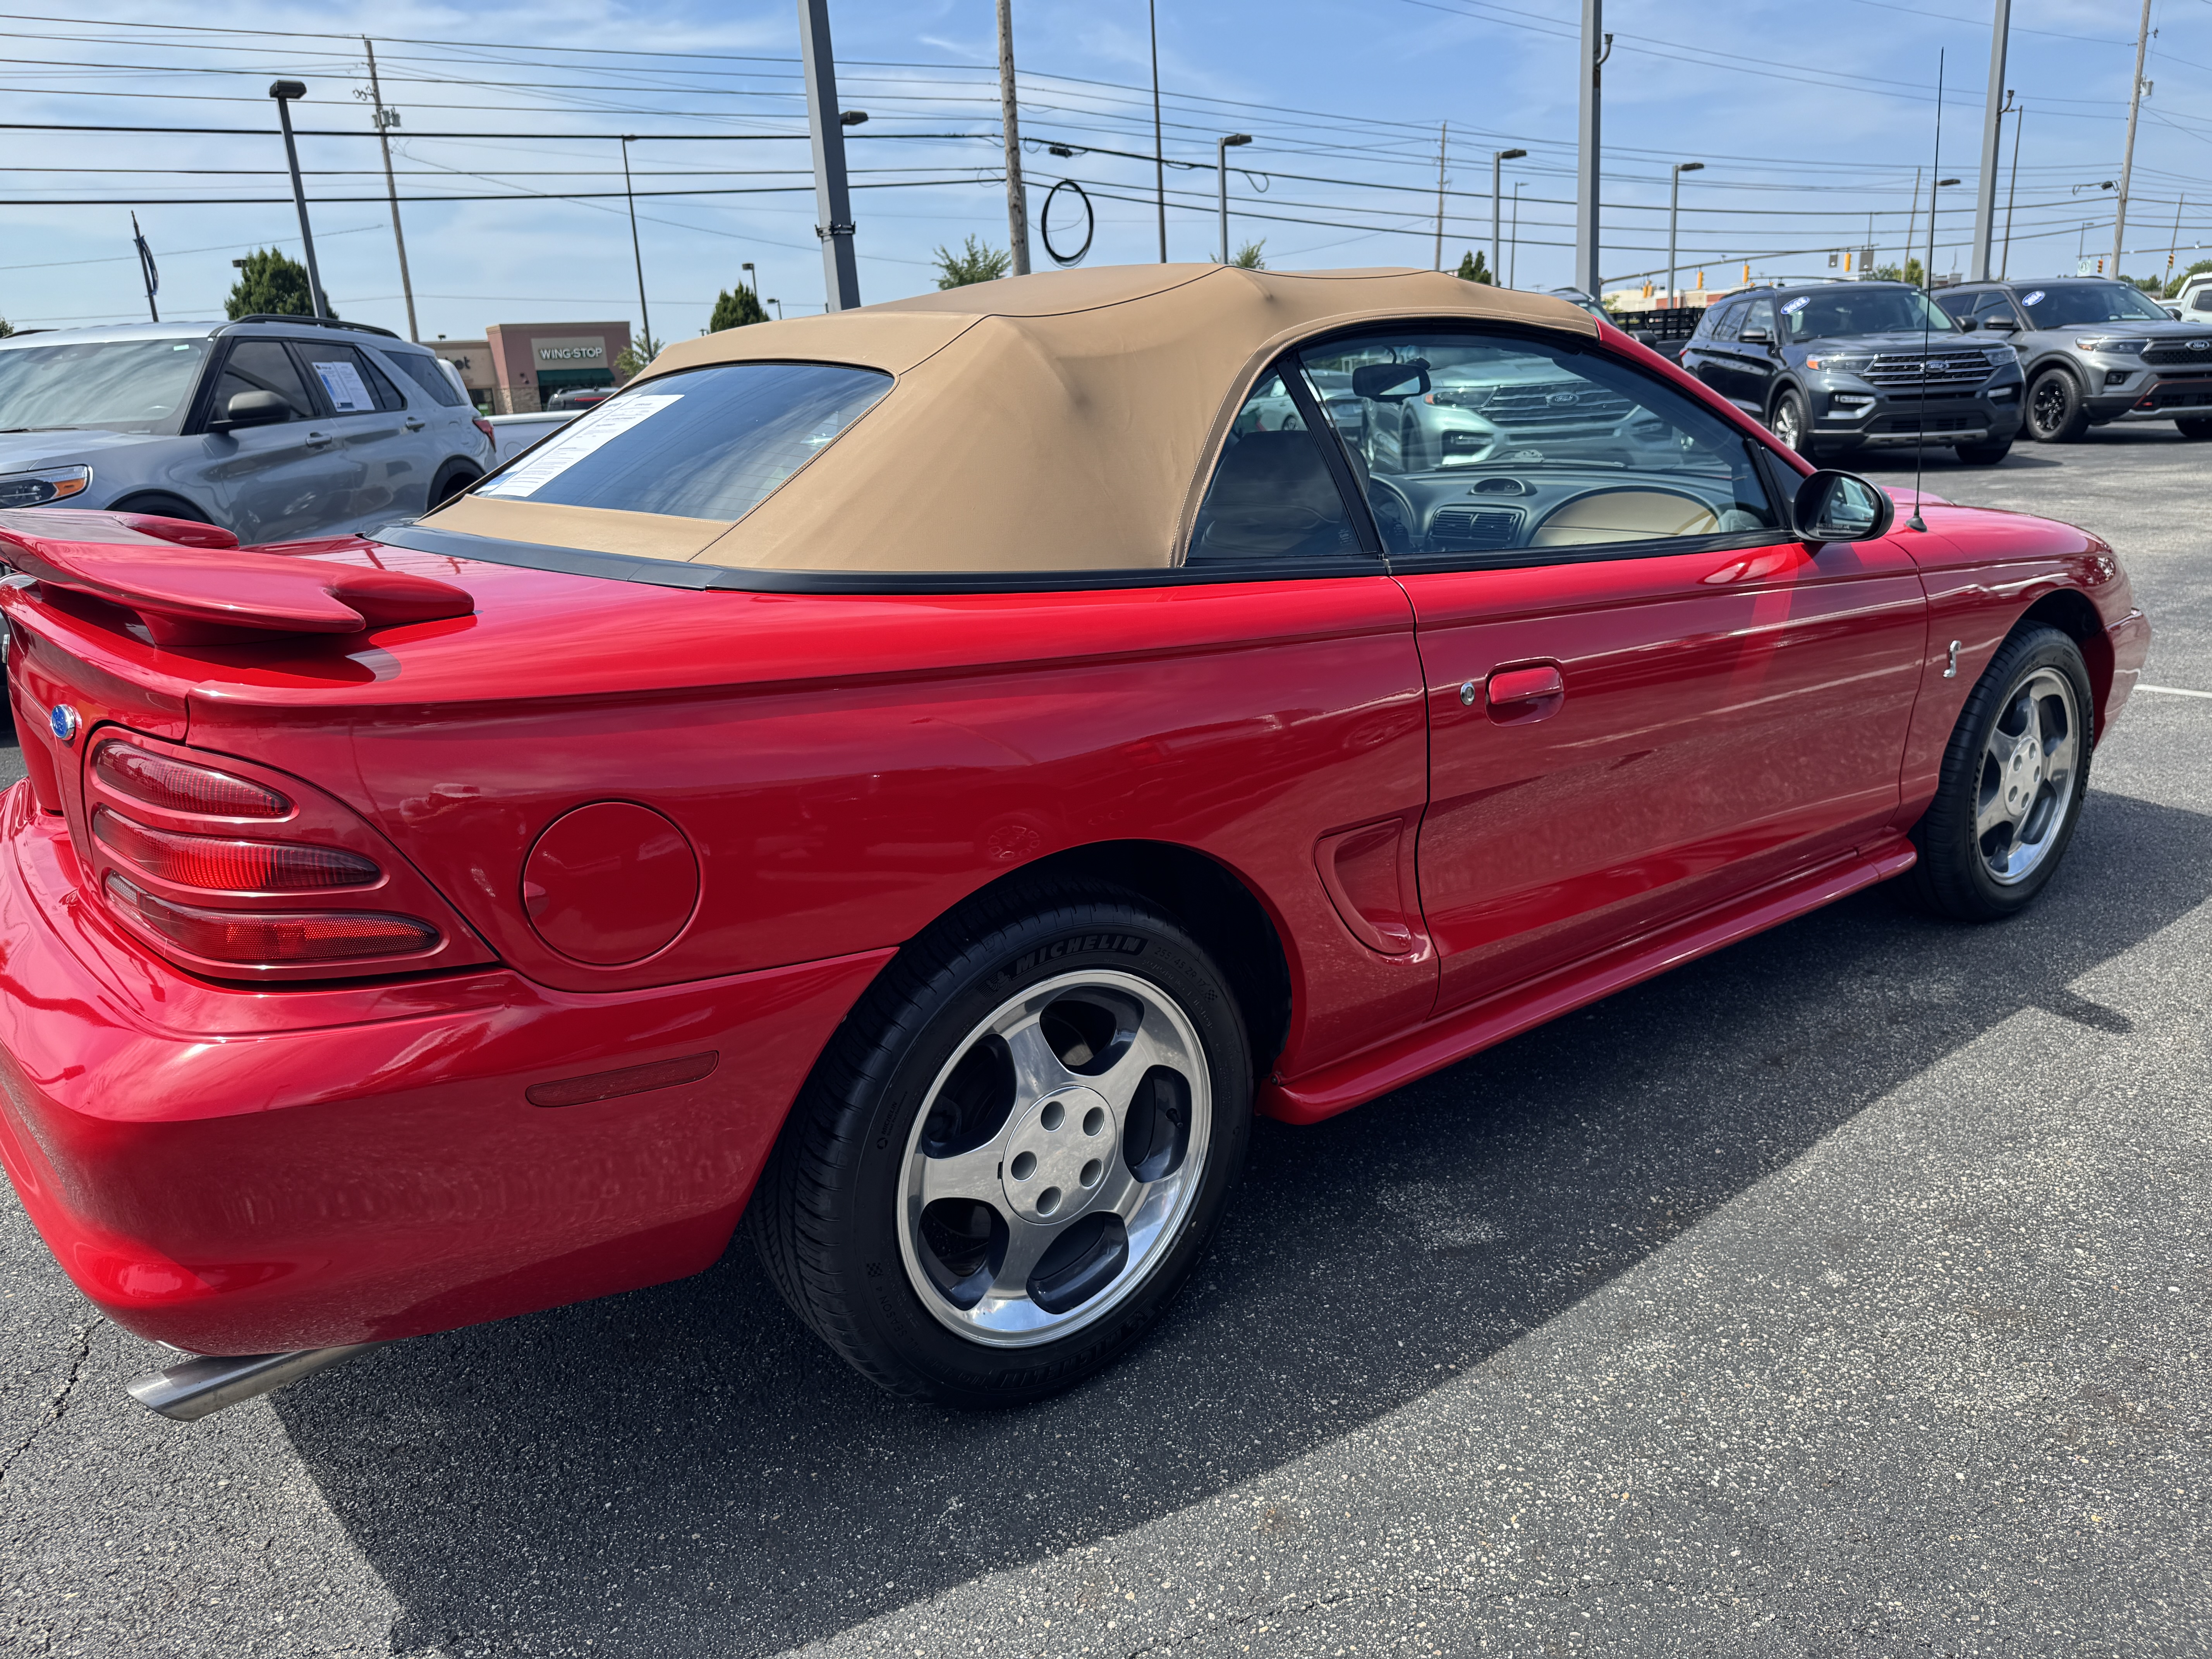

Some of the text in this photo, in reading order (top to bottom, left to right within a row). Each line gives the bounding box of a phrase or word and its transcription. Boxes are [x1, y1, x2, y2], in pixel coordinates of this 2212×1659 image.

[1015, 934, 1141, 975] MICHELIN
[1154, 947, 1186, 969] 255/45
[1185, 967, 1197, 979] ZR
[881, 1102, 897, 1135] MICHELIN
[879, 1295, 908, 1337] SEASON
[907, 1337, 922, 1353] ALL
[1001, 1329, 1122, 1388] MICHELIN
[924, 1355, 954, 1376] SPORT
[958, 1372, 986, 1387] PILOT
